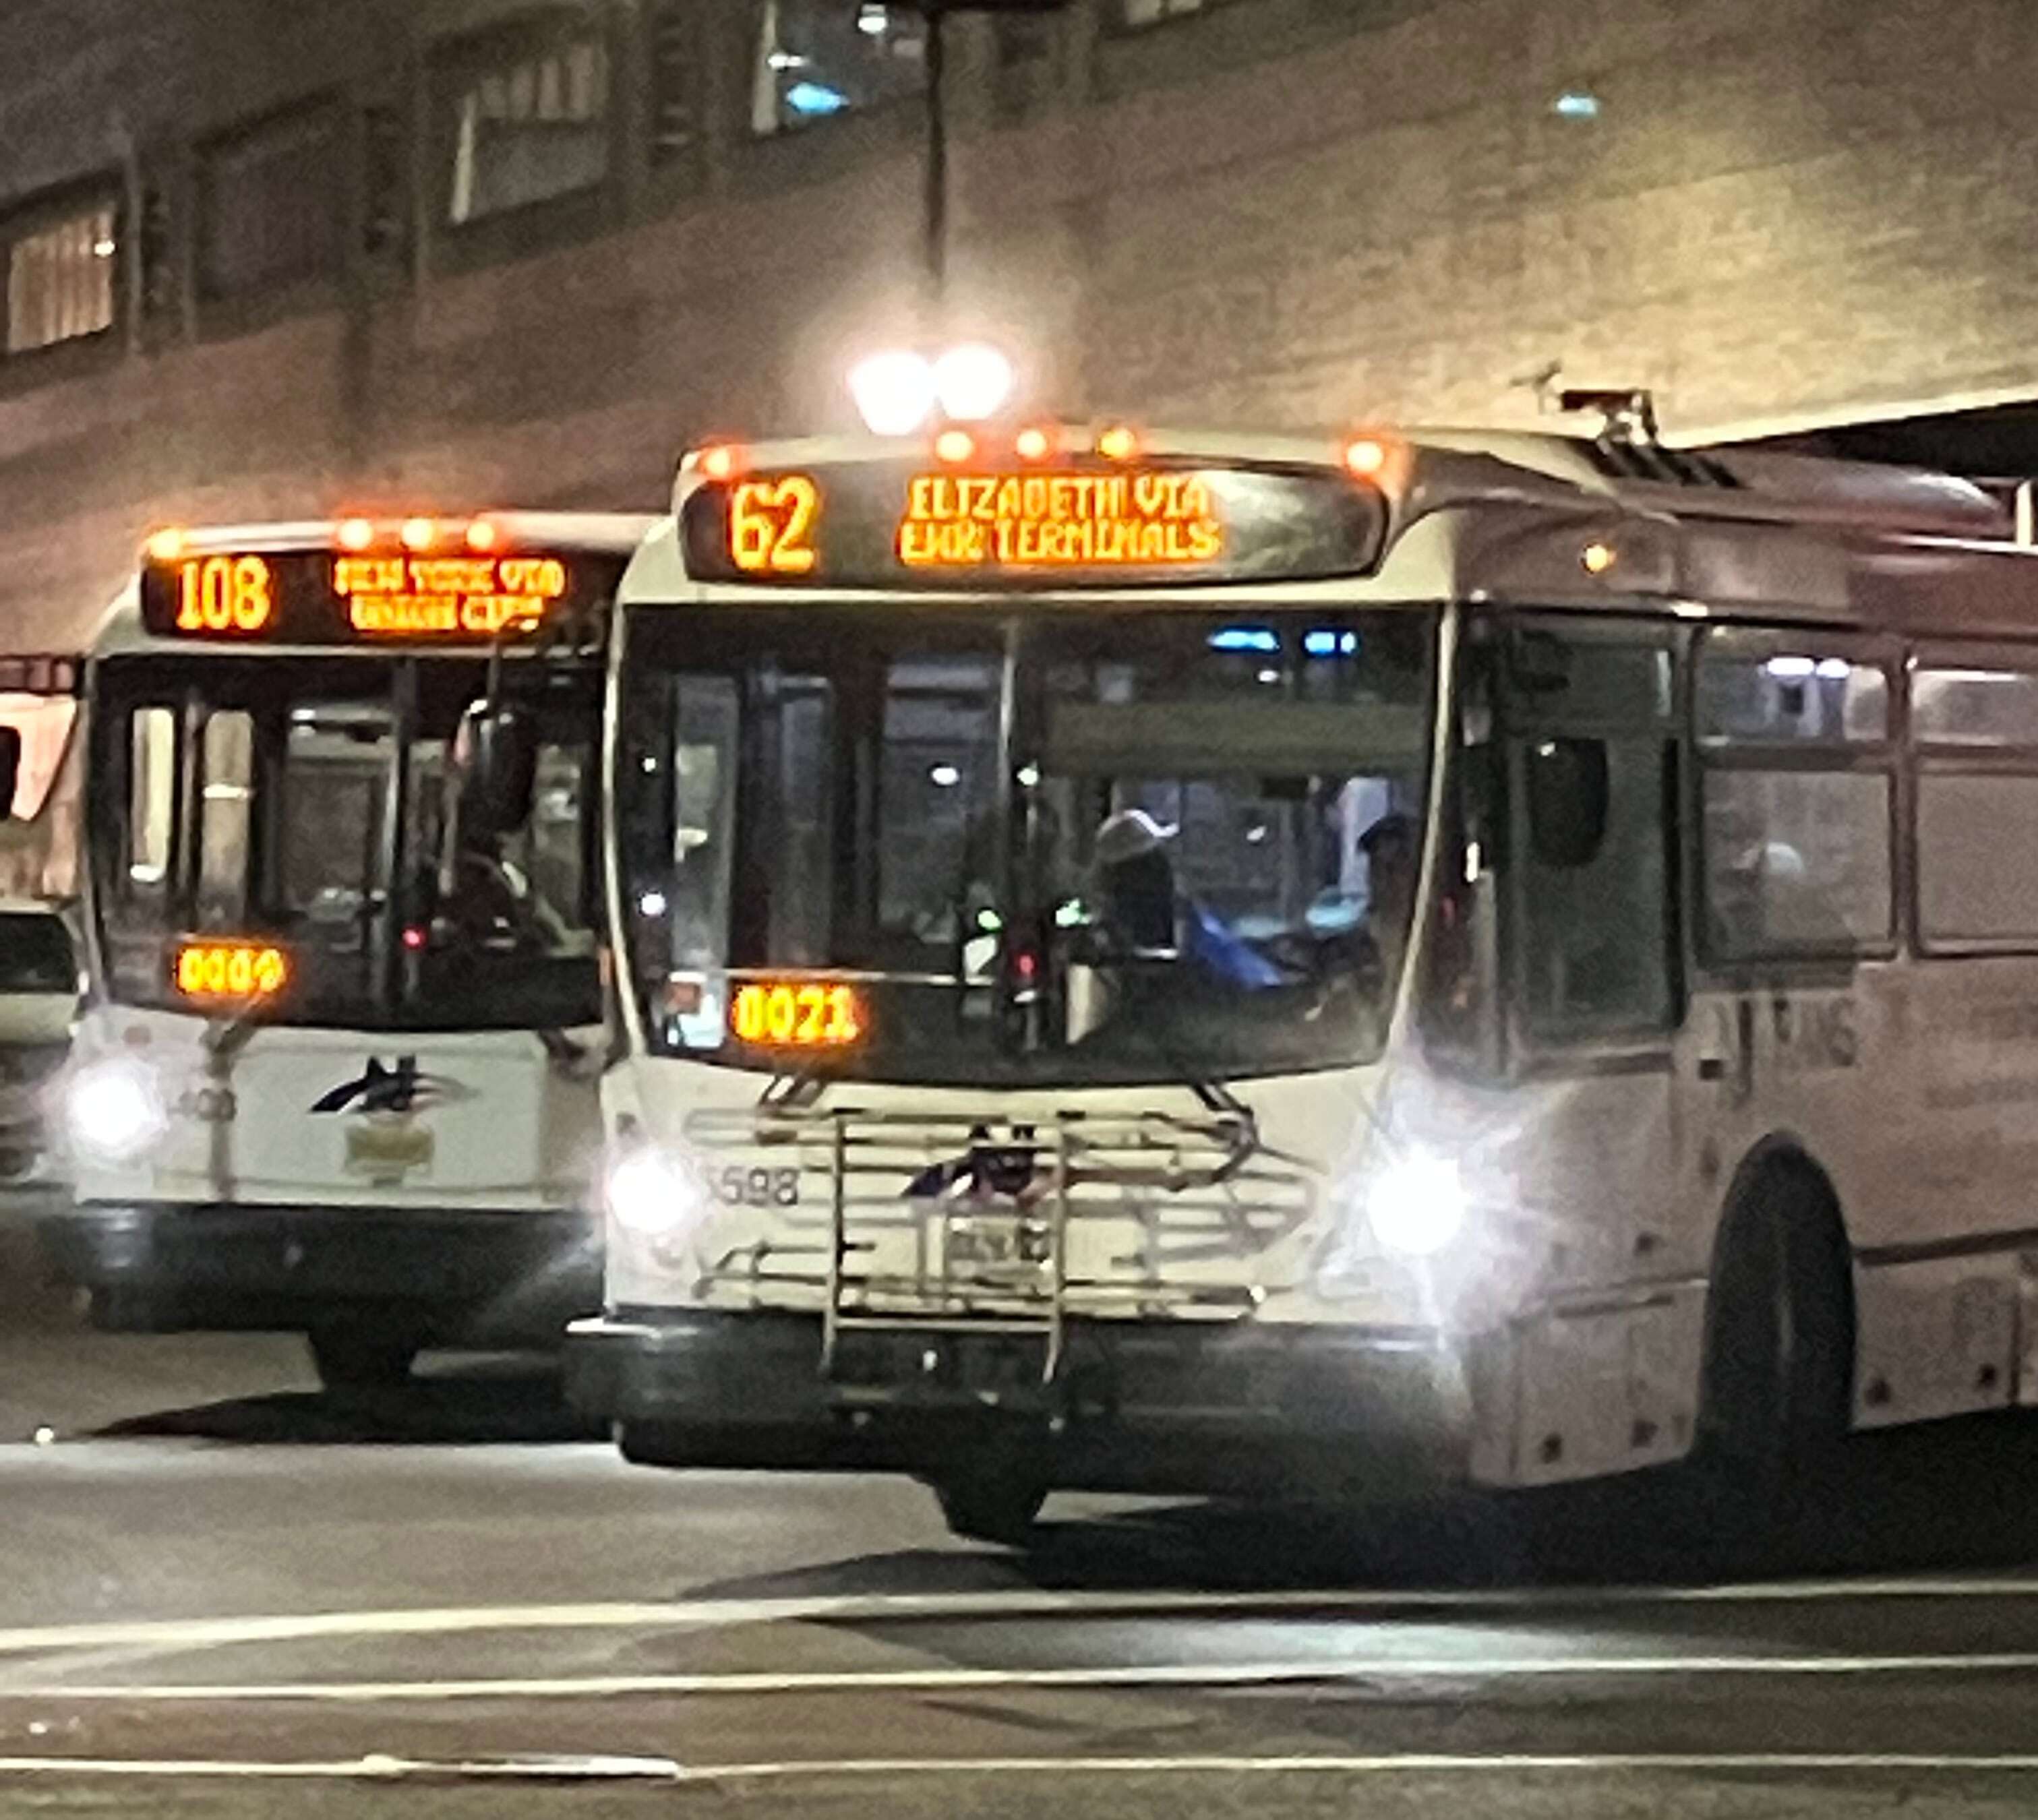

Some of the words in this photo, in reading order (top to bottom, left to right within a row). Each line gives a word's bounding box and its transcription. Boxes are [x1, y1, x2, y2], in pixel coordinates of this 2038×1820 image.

[730, 476, 815, 571] 62
[910, 477, 1124, 519] ELIZABETH
[1135, 475, 1210, 518] VIA
[994, 518, 1222, 559] TERMINALS
[177, 556, 268, 630] 108
[736, 985, 860, 1043] 0021
